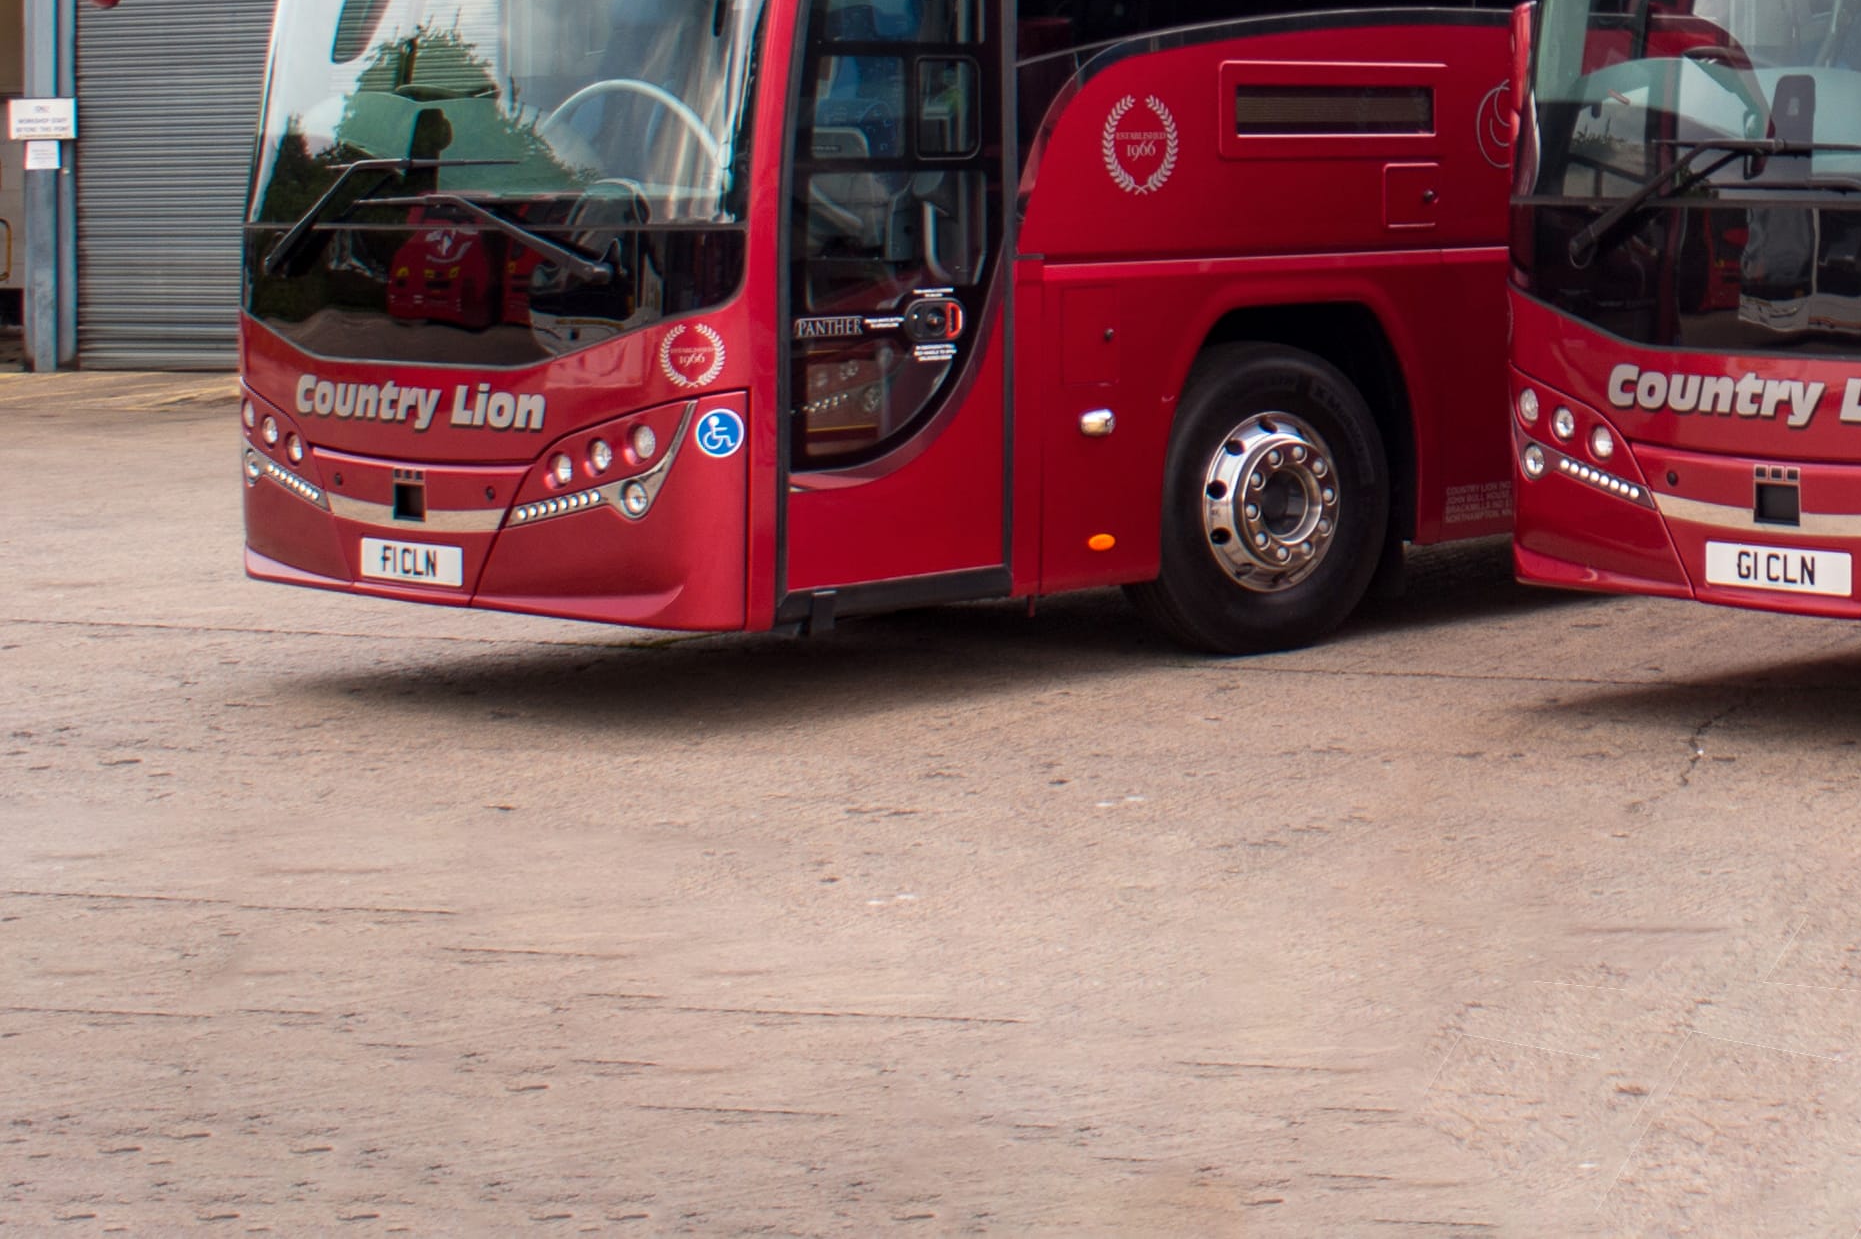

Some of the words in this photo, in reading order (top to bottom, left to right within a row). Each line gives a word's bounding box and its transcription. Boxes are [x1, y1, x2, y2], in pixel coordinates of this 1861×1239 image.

[1116, 131, 1167, 141] ESTABLISHED
[1126, 140, 1157, 161] 1966
[796, 318, 863, 338] PANTHER
[680, 352, 705, 367] 1966
[295, 373, 442, 431] Country
[450, 383, 546, 431] Lion
[1607, 364, 1826, 428] Country
[401, 547, 437, 577] CLN
[1766, 553, 1815, 586] CLN
